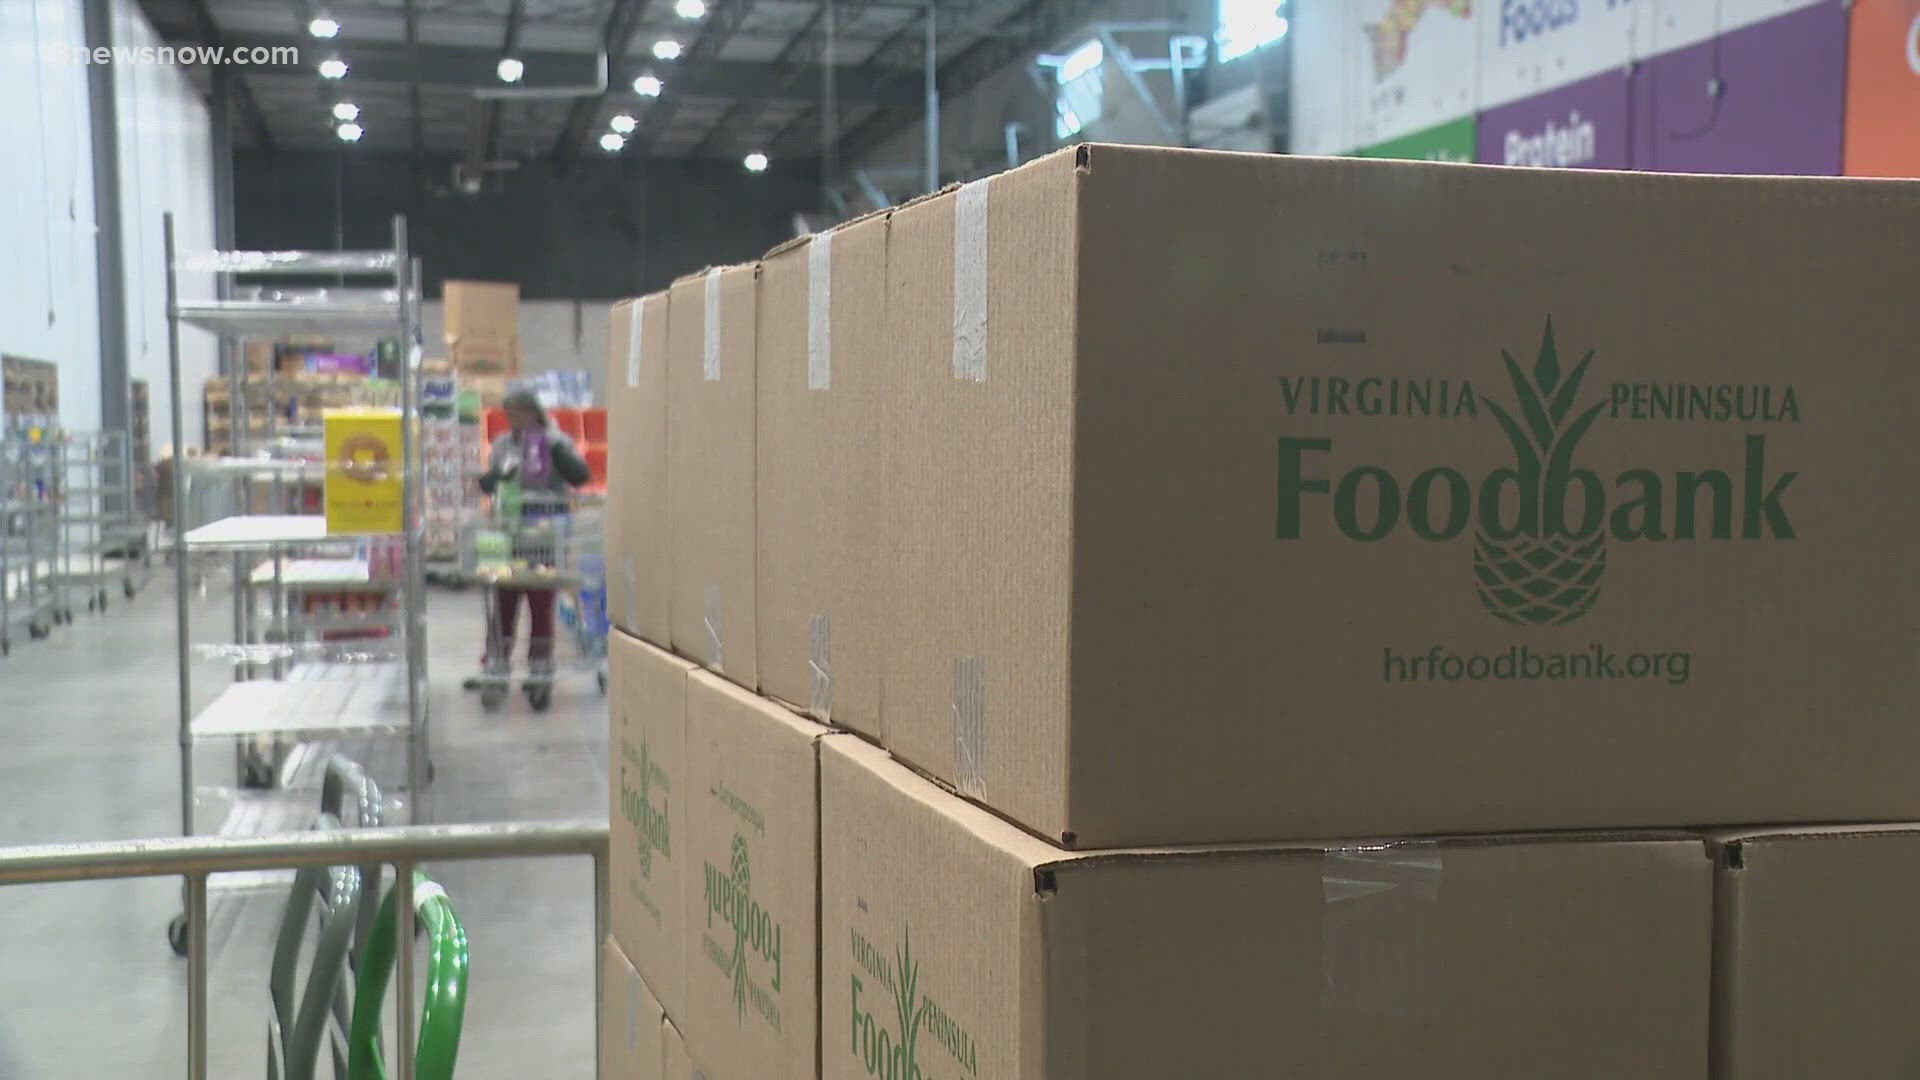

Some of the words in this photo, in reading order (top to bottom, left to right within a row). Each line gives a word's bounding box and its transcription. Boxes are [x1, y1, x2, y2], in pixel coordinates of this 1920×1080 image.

[1503, 109, 1595, 168] Protein
[1278, 375, 1478, 417] VIRGINIA
[1610, 382, 1800, 422] PENINSULA
[1275, 433, 1799, 543] Foodbank
[1383, 644, 1691, 685] hrfoodbank.org
[851, 927, 892, 995] VIRGINIA
[923, 994, 977, 1078] PENINSULA
[852, 973, 967, 1080] Foodb
